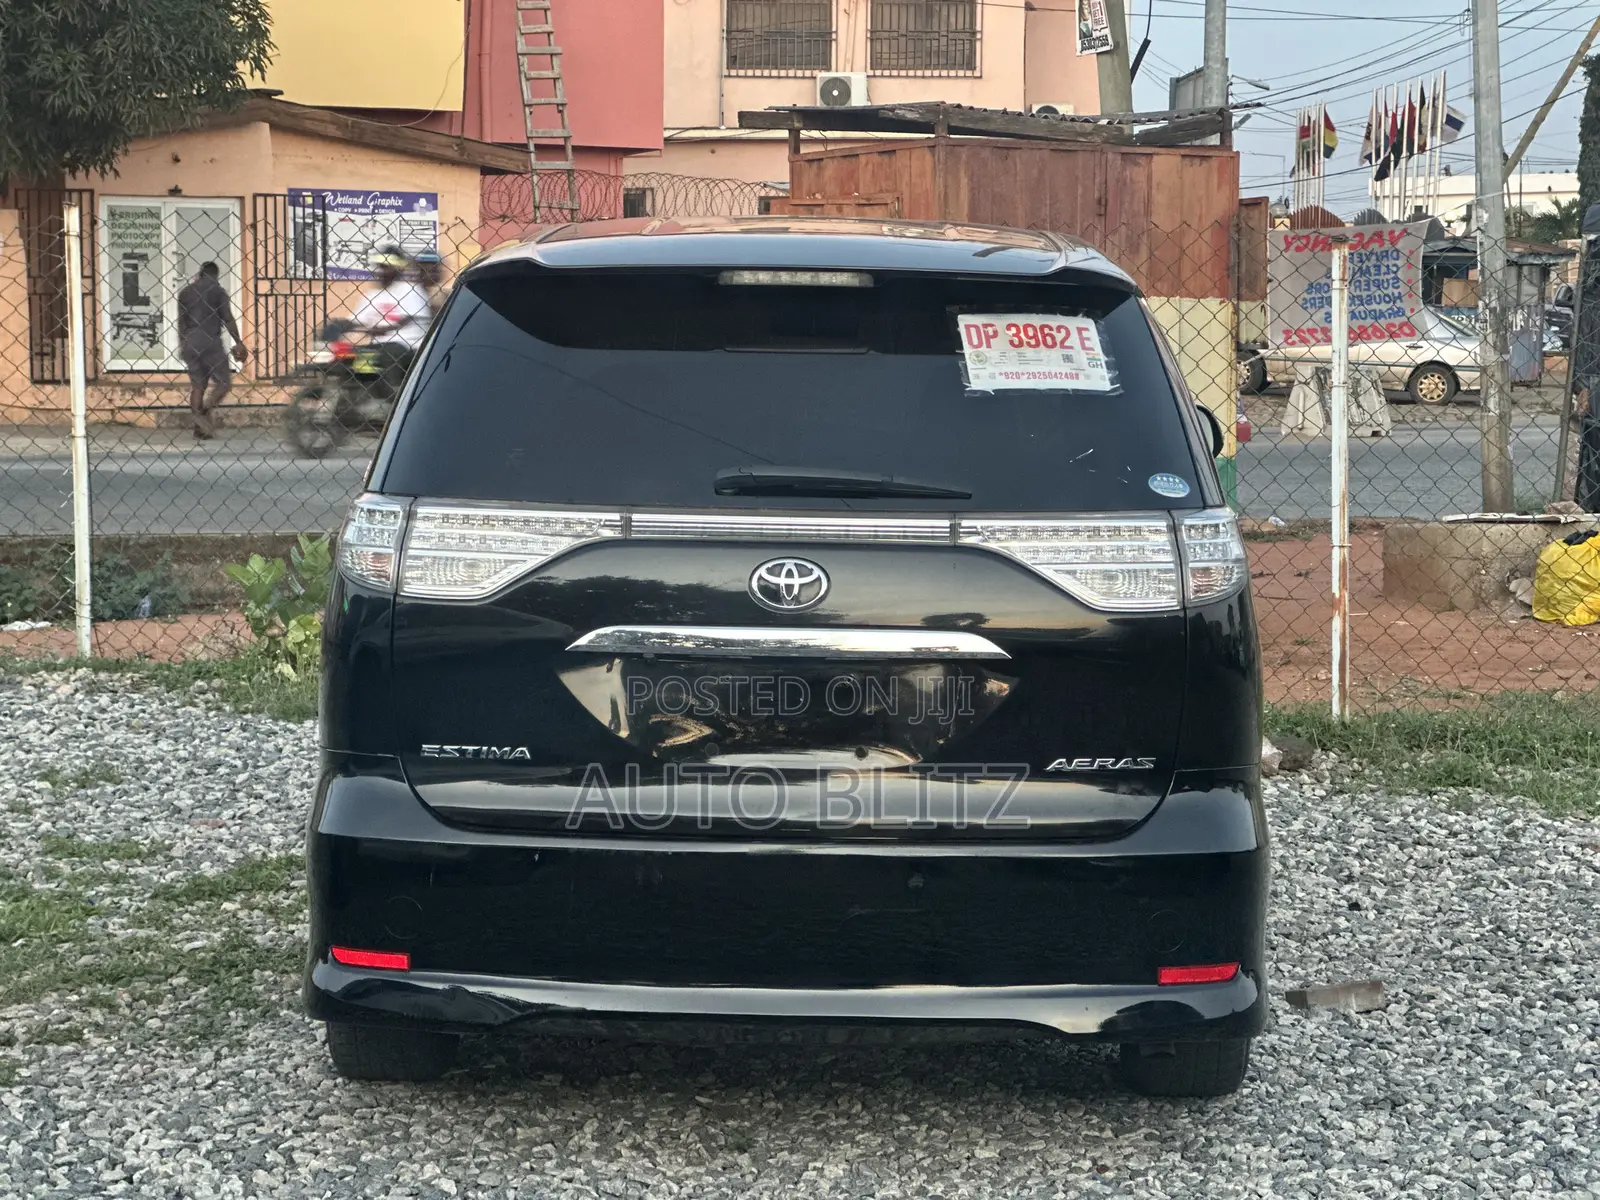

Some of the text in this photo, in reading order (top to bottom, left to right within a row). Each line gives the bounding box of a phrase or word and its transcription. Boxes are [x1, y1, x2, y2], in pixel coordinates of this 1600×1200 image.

[322, 191, 363, 206] Wetland
[964, 323, 1096, 351] DP 3962 E
[1087, 361, 1104, 370] GH
[420, 744, 532, 759] ESTIMA
[1043, 757, 1157, 771] AERAS
